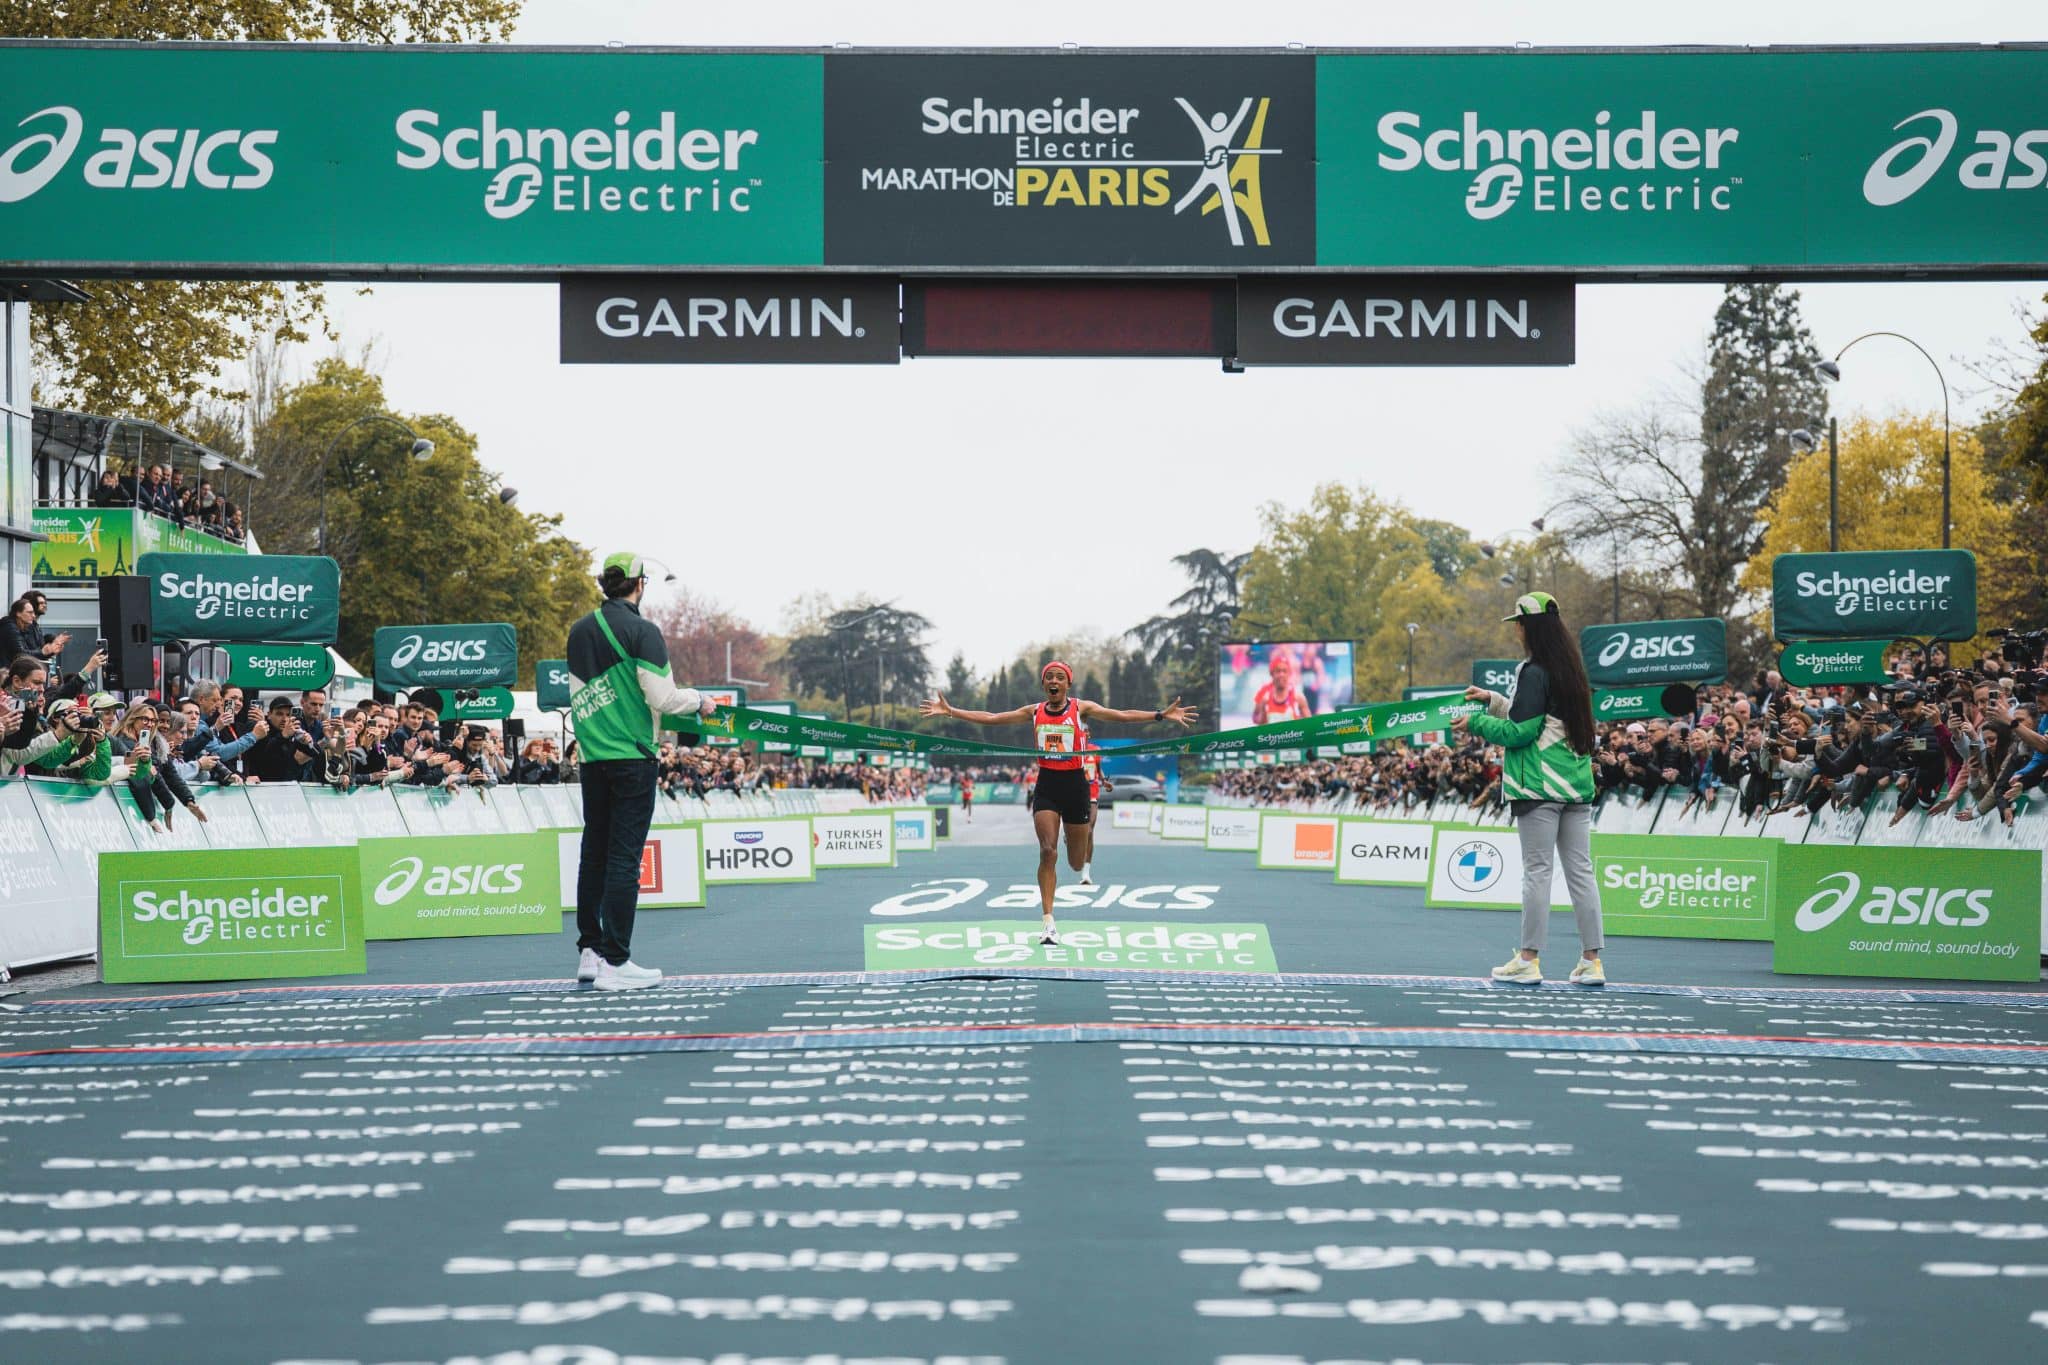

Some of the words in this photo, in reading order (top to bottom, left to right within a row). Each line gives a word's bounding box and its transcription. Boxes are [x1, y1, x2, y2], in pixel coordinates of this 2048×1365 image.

[921, 97, 1139, 135] Schneider
[394, 109, 759, 173] Schneider
[1015, 136, 1135, 159] Electric
[1376, 110, 1739, 172] Schneider
[82, 127, 279, 190] asics
[862, 168, 1014, 191] MARATHON
[1016, 168, 1171, 207] PARIS
[993, 191, 1014, 207] DE
[48, 533, 77, 543] ARIS
[159, 572, 313, 602] Schneider
[1796, 569, 1951, 597] Schneider
[421, 639, 487, 662] asics
[1629, 634, 1696, 659] asics
[248, 656, 317, 669] Schneider
[1692, 660, 1712, 672] body
[1795, 652, 1865, 666] Schneider
[1825, 663, 1864, 673] Electric
[277, 668, 315, 677] Electric
[571, 674, 611, 713] IMPACT
[576, 688, 618, 722] MAKER
[1613, 696, 1643, 707] asics
[1399, 711, 1427, 724] asics
[1438, 702, 1484, 716] Schneider
[801, 726, 848, 739] Schneider
[1257, 729, 1305, 745] Schneider
[825, 840, 883, 851] AIRLINES
[826, 829, 883, 843] TURKISH
[705, 846, 793, 870] HiPRO
[1350, 844, 1429, 861] GARMI
[423, 863, 525, 896] asics
[1603, 863, 1757, 893] Schneider
[132, 887, 329, 922] Schneider
[416, 906, 450, 918] sound
[452, 905, 481, 917] mind,
[483, 904, 518, 916] sound
[518, 903, 547, 916] body
[1859, 886, 1993, 927] asics
[874, 925, 1257, 951] Schneider
[1848, 938, 1893, 952] sound
[1894, 939, 1932, 954] mind,
[1935, 940, 1980, 954] sound
[1982, 942, 2021, 959] body
[1044, 947, 1256, 966] Electric
